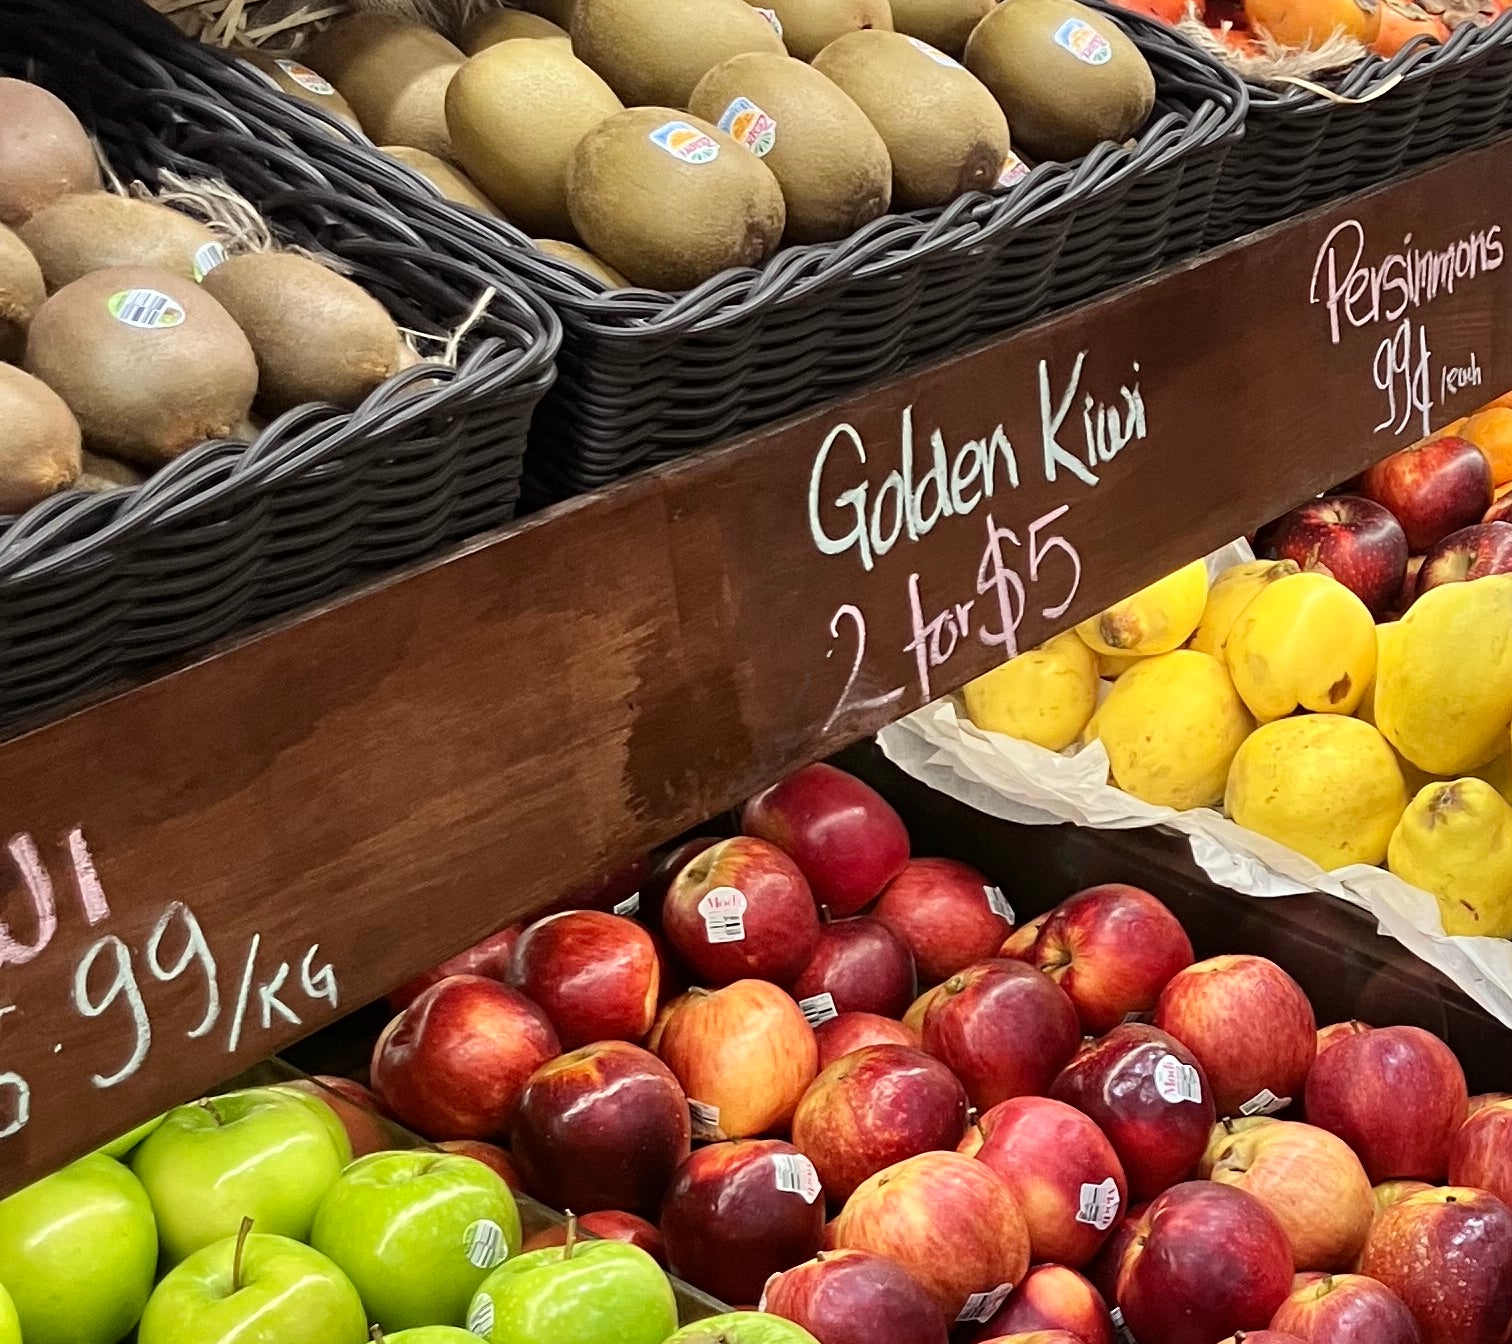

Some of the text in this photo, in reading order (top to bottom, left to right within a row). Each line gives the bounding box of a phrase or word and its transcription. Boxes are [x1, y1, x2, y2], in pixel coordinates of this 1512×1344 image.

[1311, 219, 1503, 344] Persimmons
[809, 350, 1147, 571] Golden Kiwi
[823, 504, 1082, 733] 2 for $5
